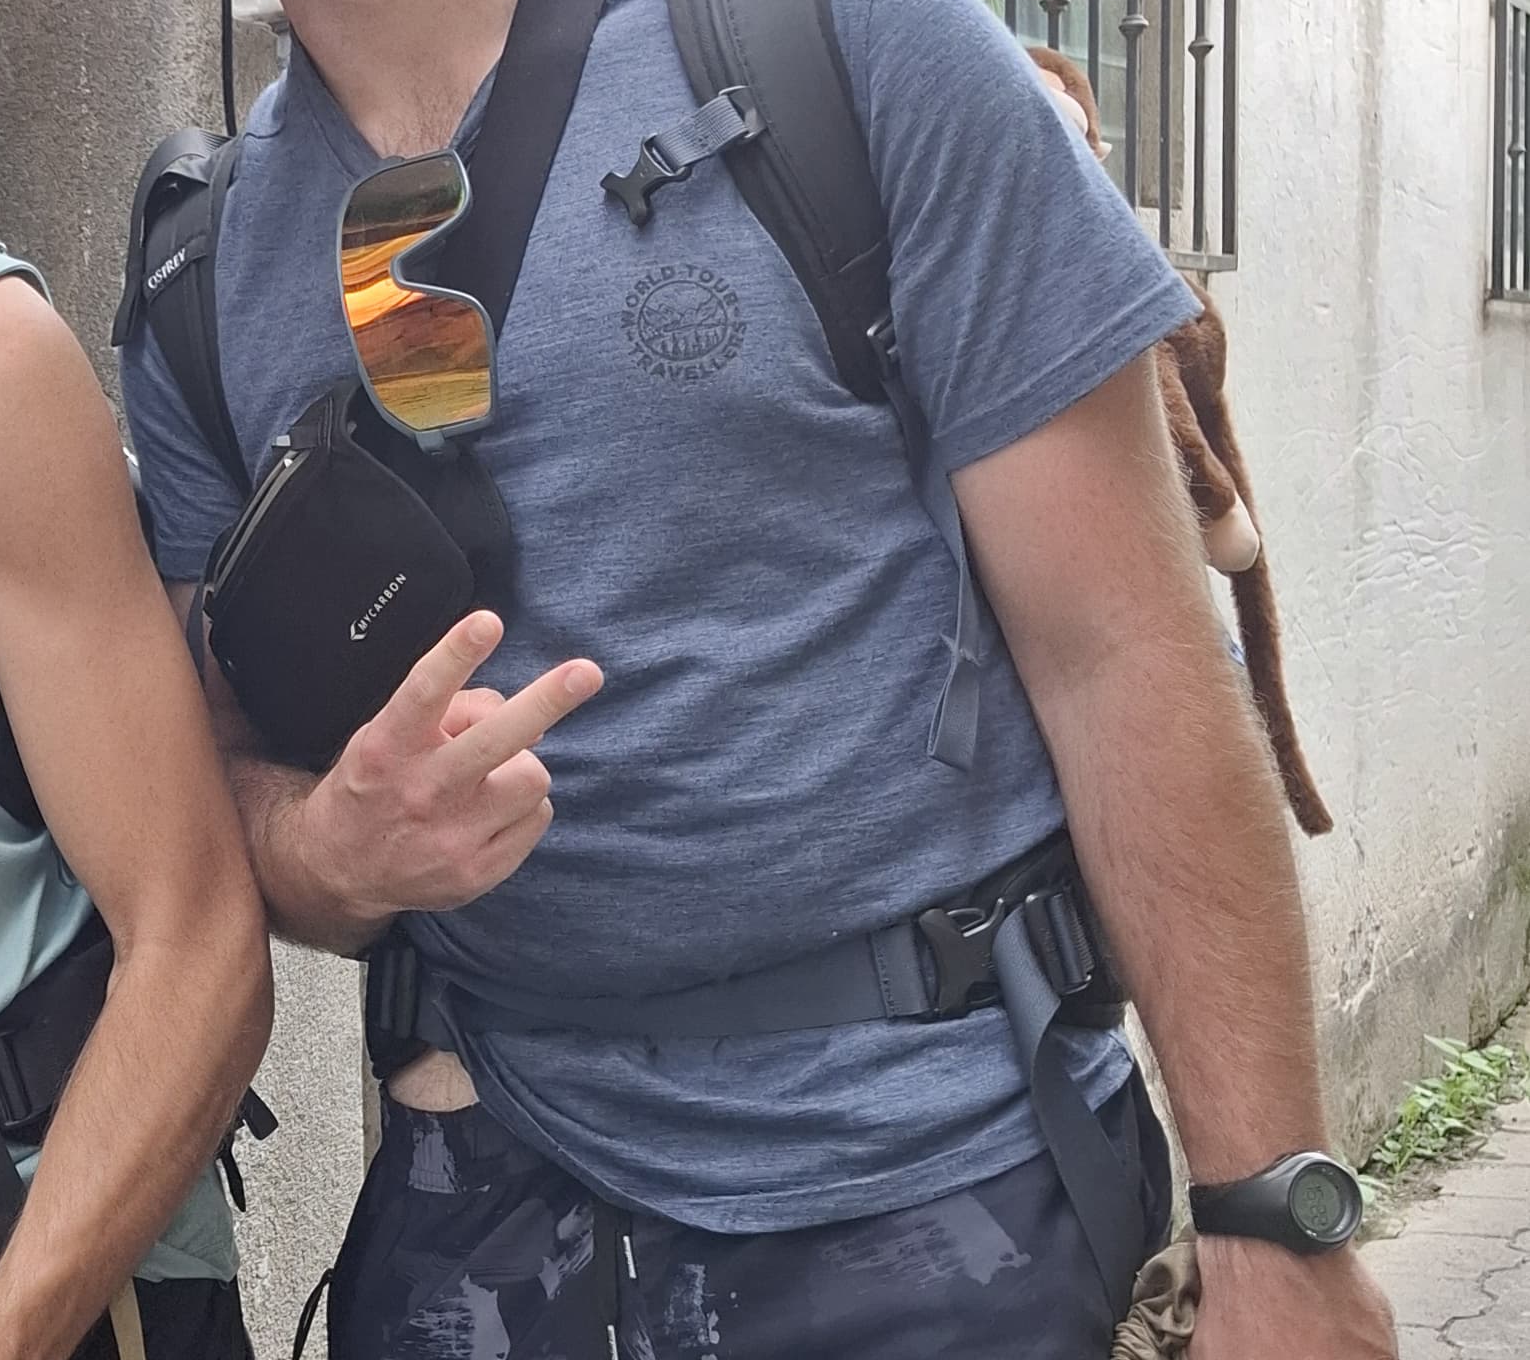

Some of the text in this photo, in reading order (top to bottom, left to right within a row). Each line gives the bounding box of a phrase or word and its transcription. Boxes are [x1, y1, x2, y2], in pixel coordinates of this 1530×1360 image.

[148, 247, 186, 289] OSPREY
[620, 263, 739, 329] WORLD TOUR
[357, 573, 407, 632] MYCARBON
